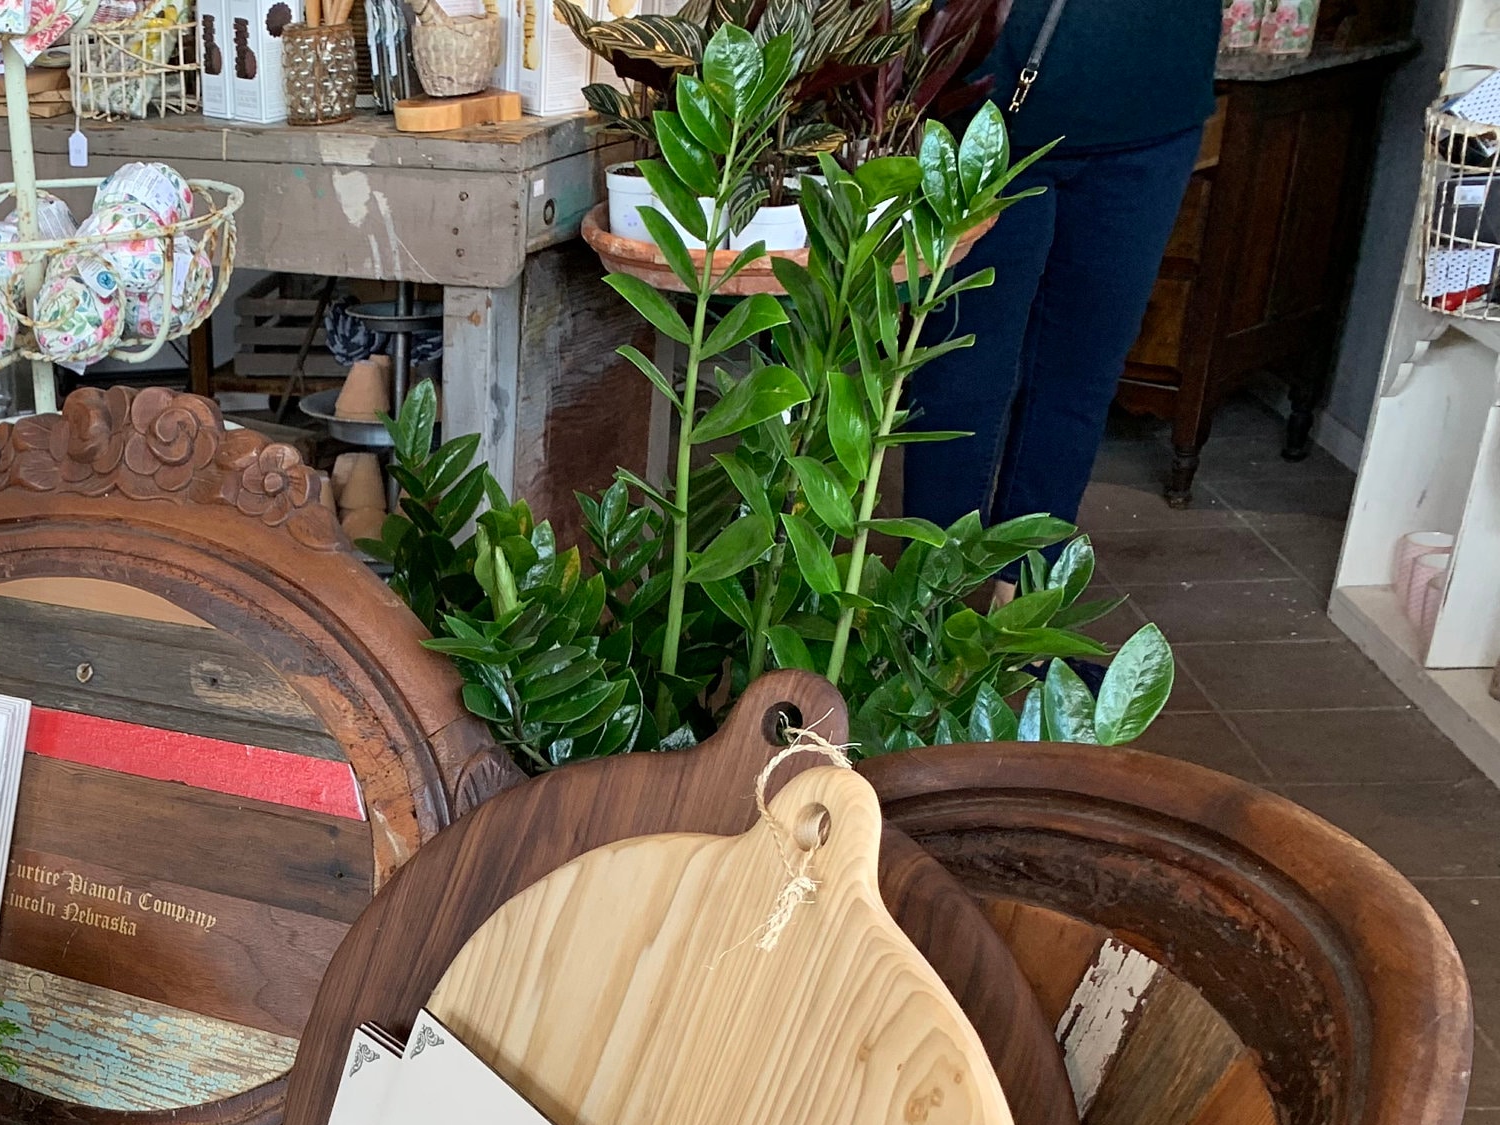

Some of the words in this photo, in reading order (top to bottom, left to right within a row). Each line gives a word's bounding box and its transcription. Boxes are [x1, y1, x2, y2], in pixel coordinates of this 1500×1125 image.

[4, 889, 56, 917] incoln
[60, 902, 138, 937] Nebraska
[61, 870, 133, 906] Pianola
[137, 892, 218, 933] Company
